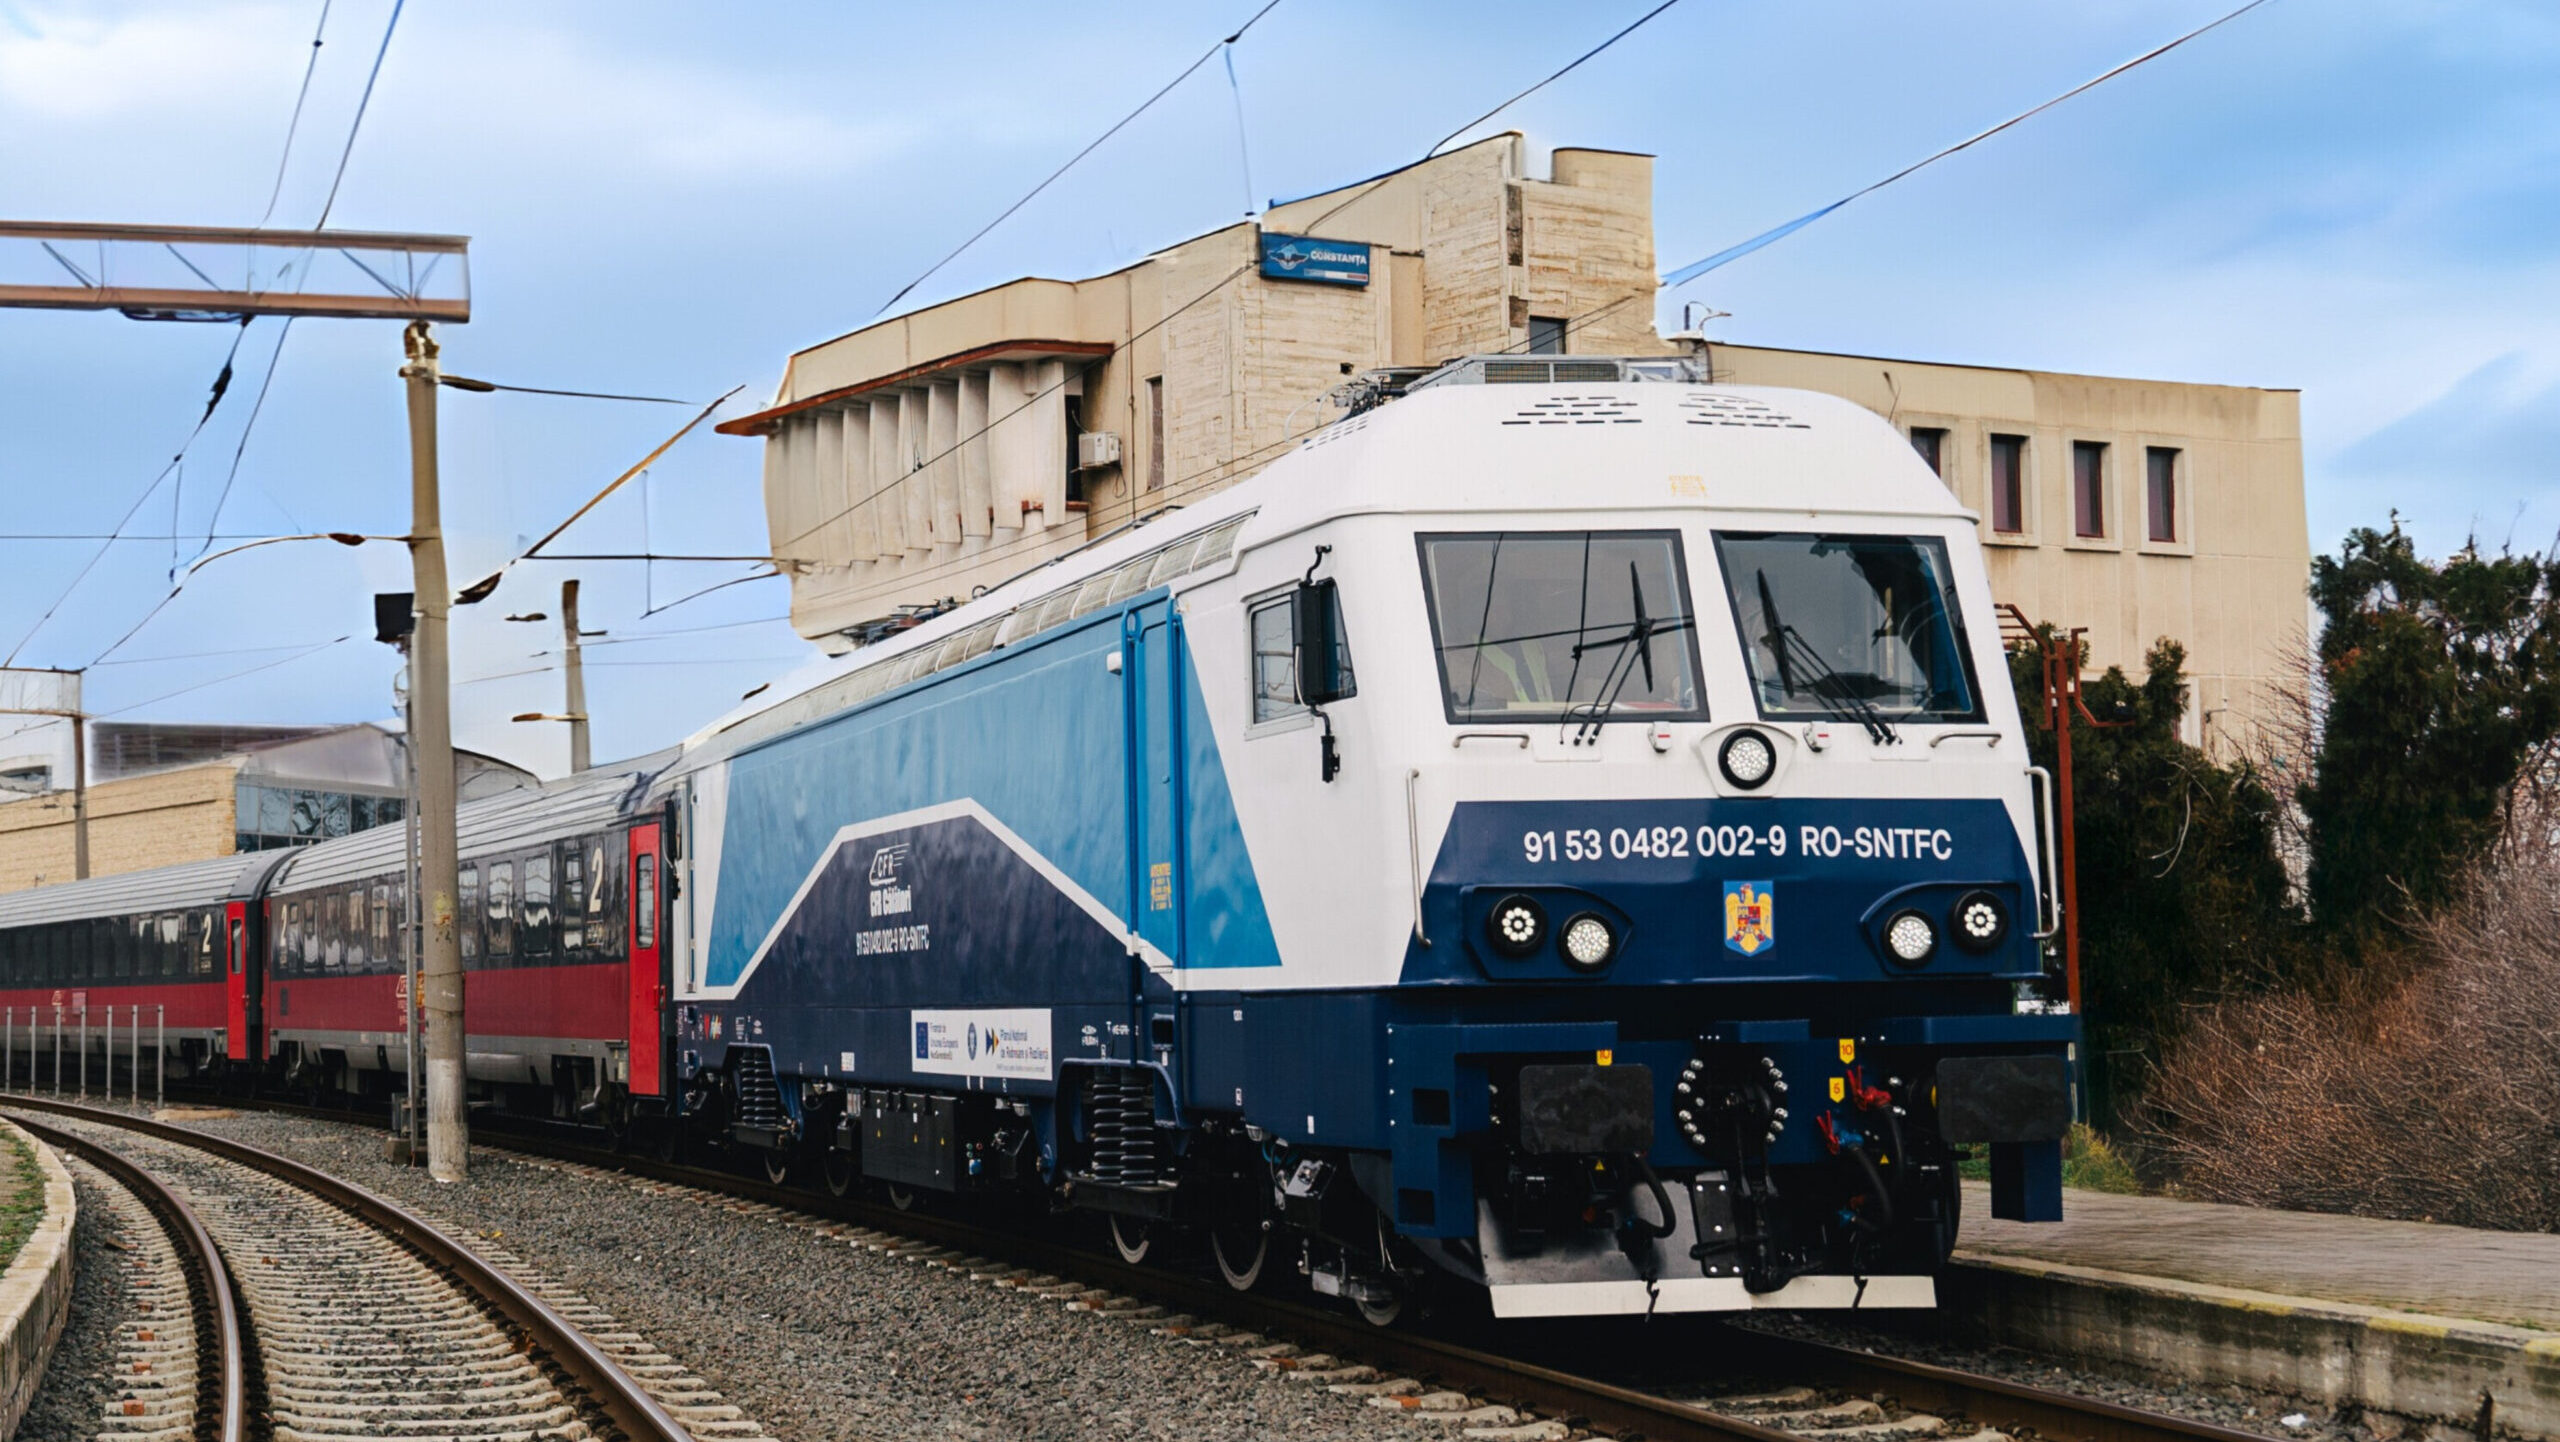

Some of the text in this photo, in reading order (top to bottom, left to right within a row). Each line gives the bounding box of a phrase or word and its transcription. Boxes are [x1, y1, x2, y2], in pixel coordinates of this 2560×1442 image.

[1523, 825, 1953, 862] 91 53 0482 002-9 RO-SNTFC
[588, 847, 604, 913] 2
[878, 853, 894, 878] CFR
[202, 913, 212, 953] 2
[280, 904, 288, 947] 2
[1841, 1044, 1853, 1056] 10
